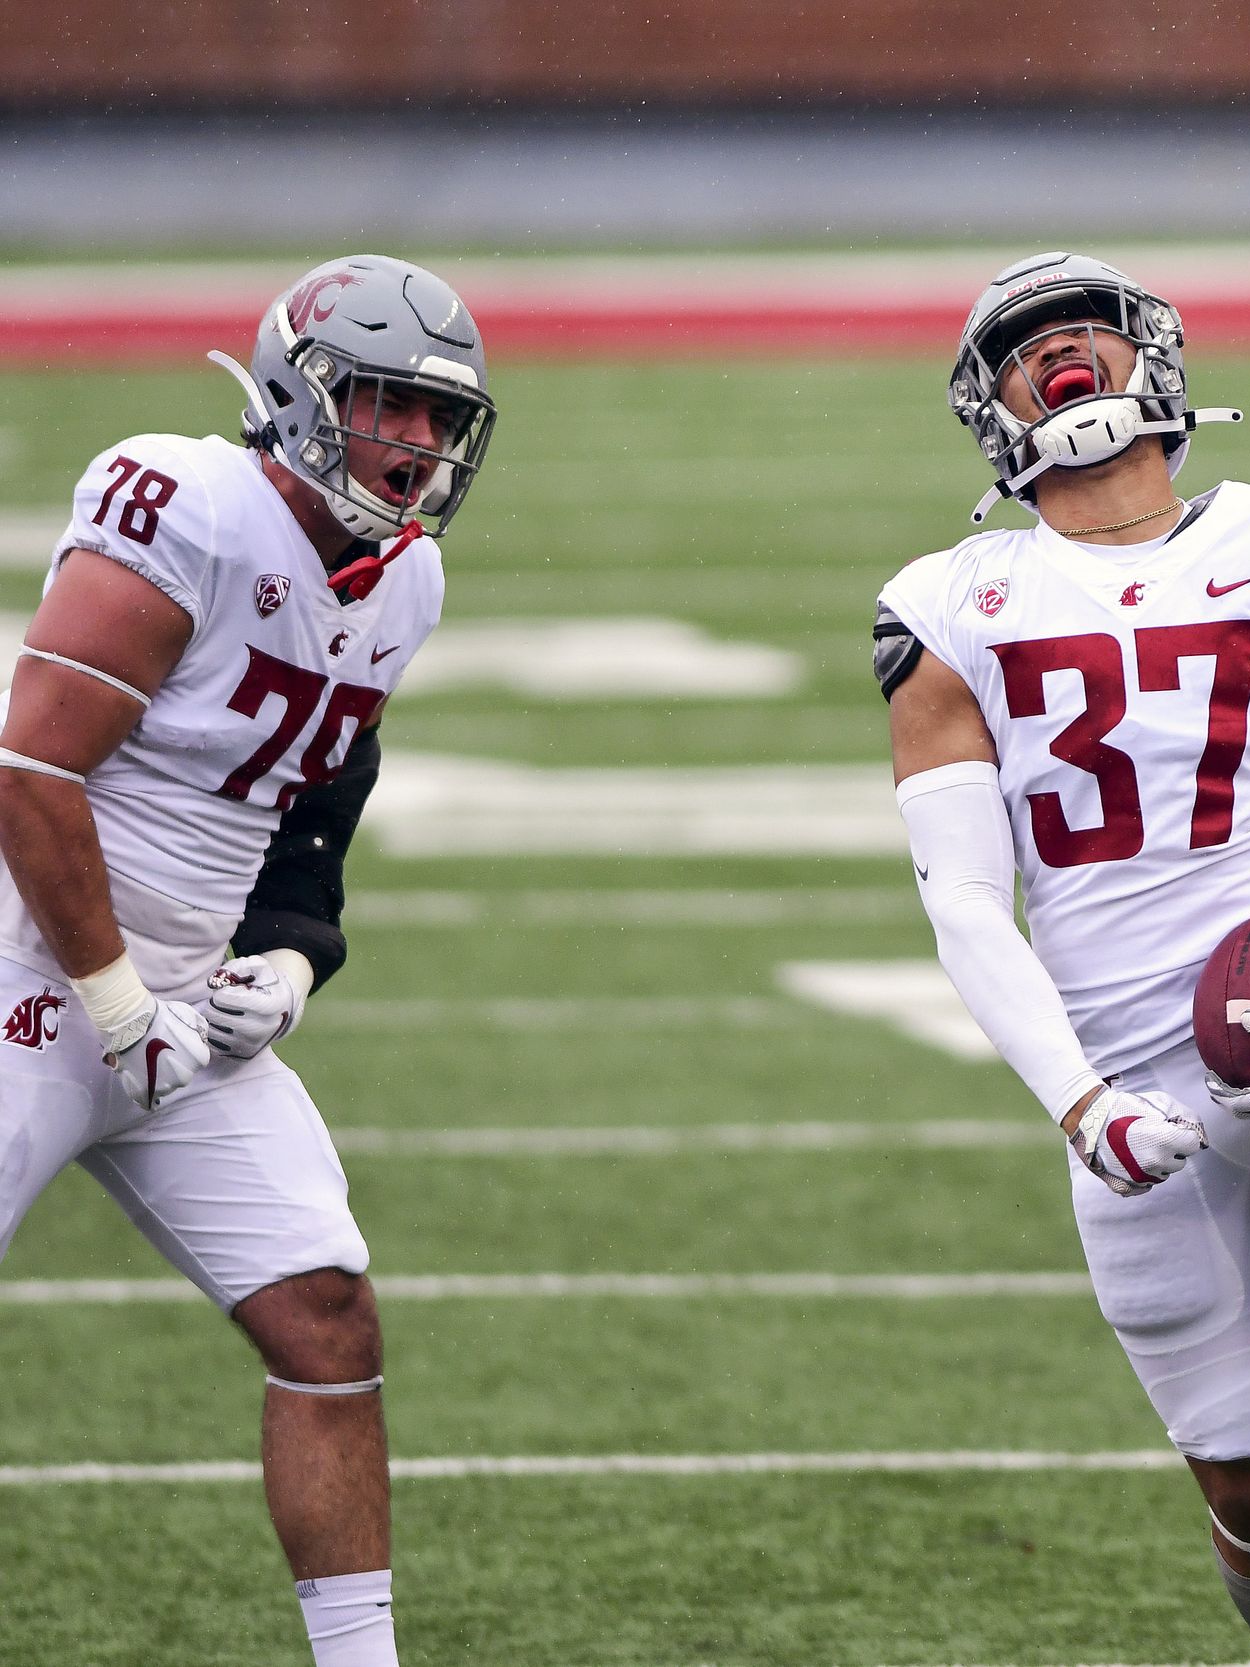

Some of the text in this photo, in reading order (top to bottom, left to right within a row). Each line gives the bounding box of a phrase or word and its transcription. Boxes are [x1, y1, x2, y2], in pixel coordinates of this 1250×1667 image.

[91, 454, 179, 546] 78
[257, 575, 290, 603] PAC
[260, 593, 278, 610] 12
[973, 578, 1007, 607] PAC
[982, 594, 1002, 611] 12
